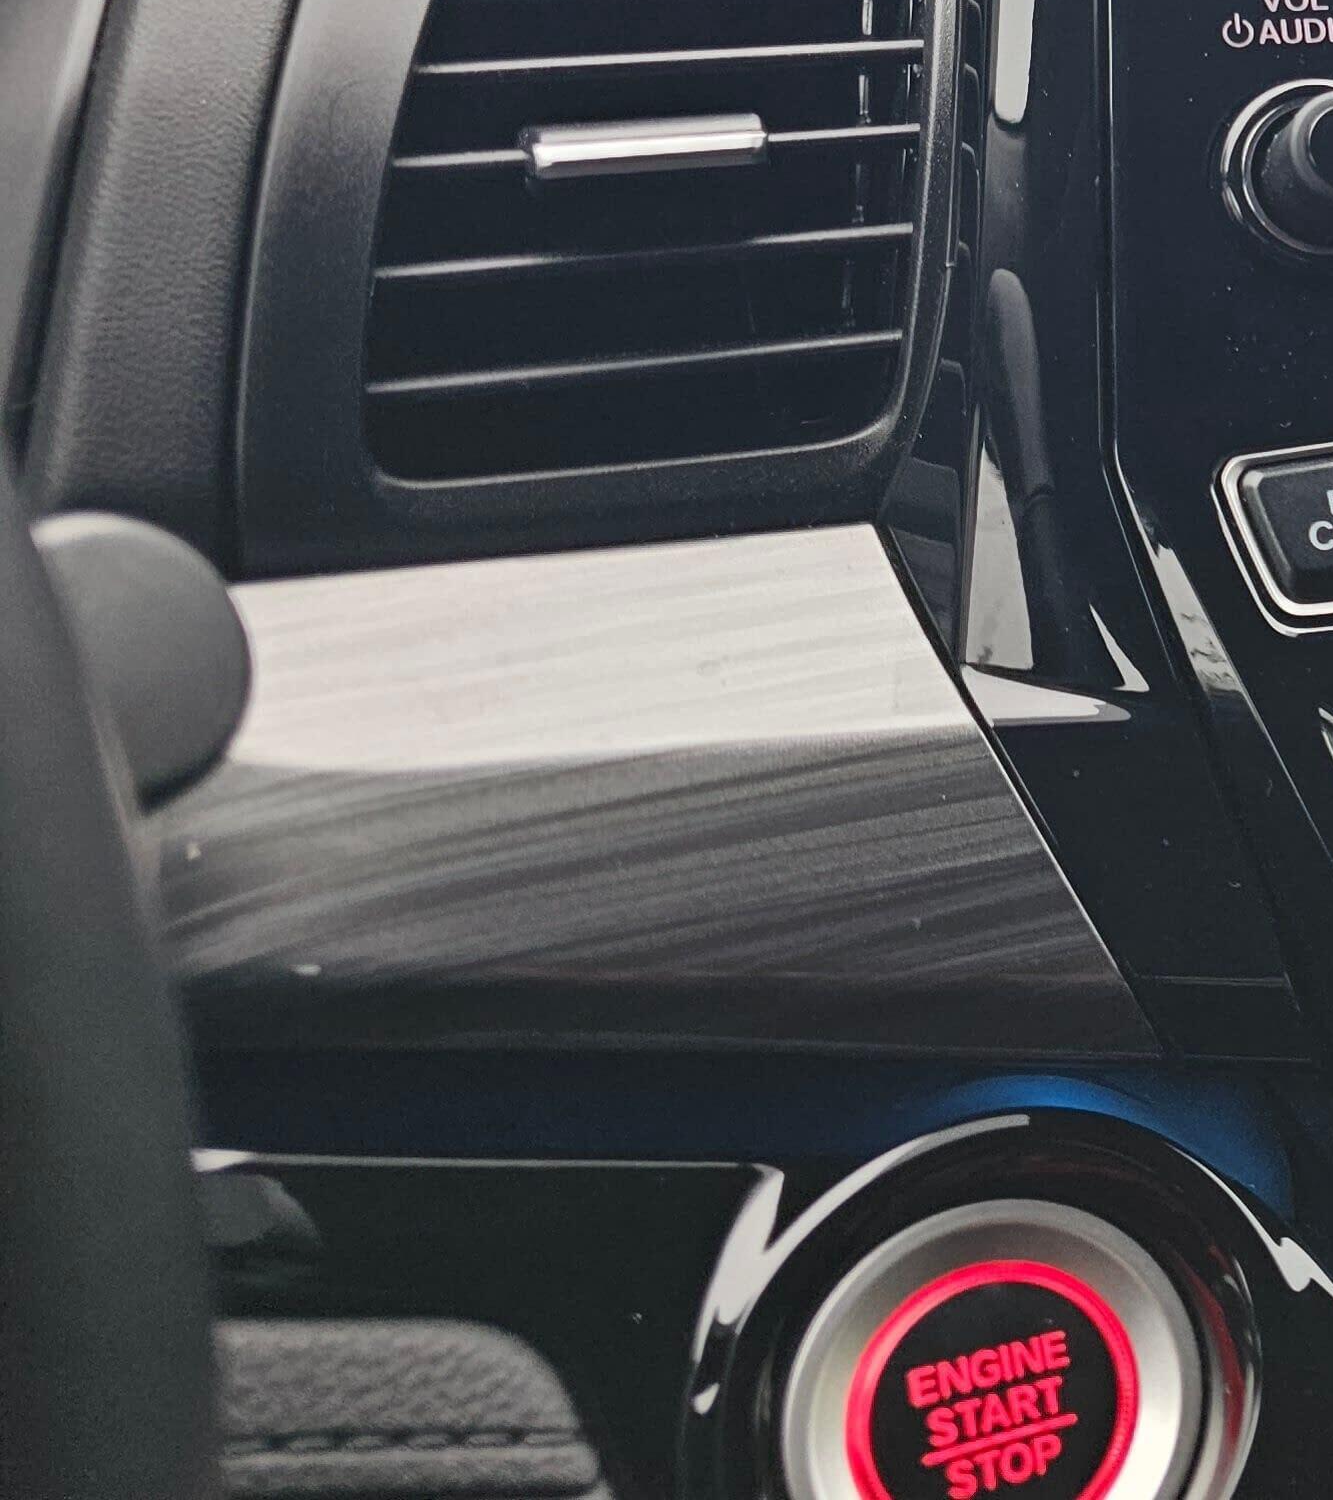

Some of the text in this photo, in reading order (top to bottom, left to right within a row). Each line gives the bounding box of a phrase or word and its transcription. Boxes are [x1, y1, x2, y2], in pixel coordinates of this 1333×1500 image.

[906, 1330, 1070, 1409] ENGINE
[925, 1375, 1063, 1447] START
[946, 1434, 1062, 1500] STOP
